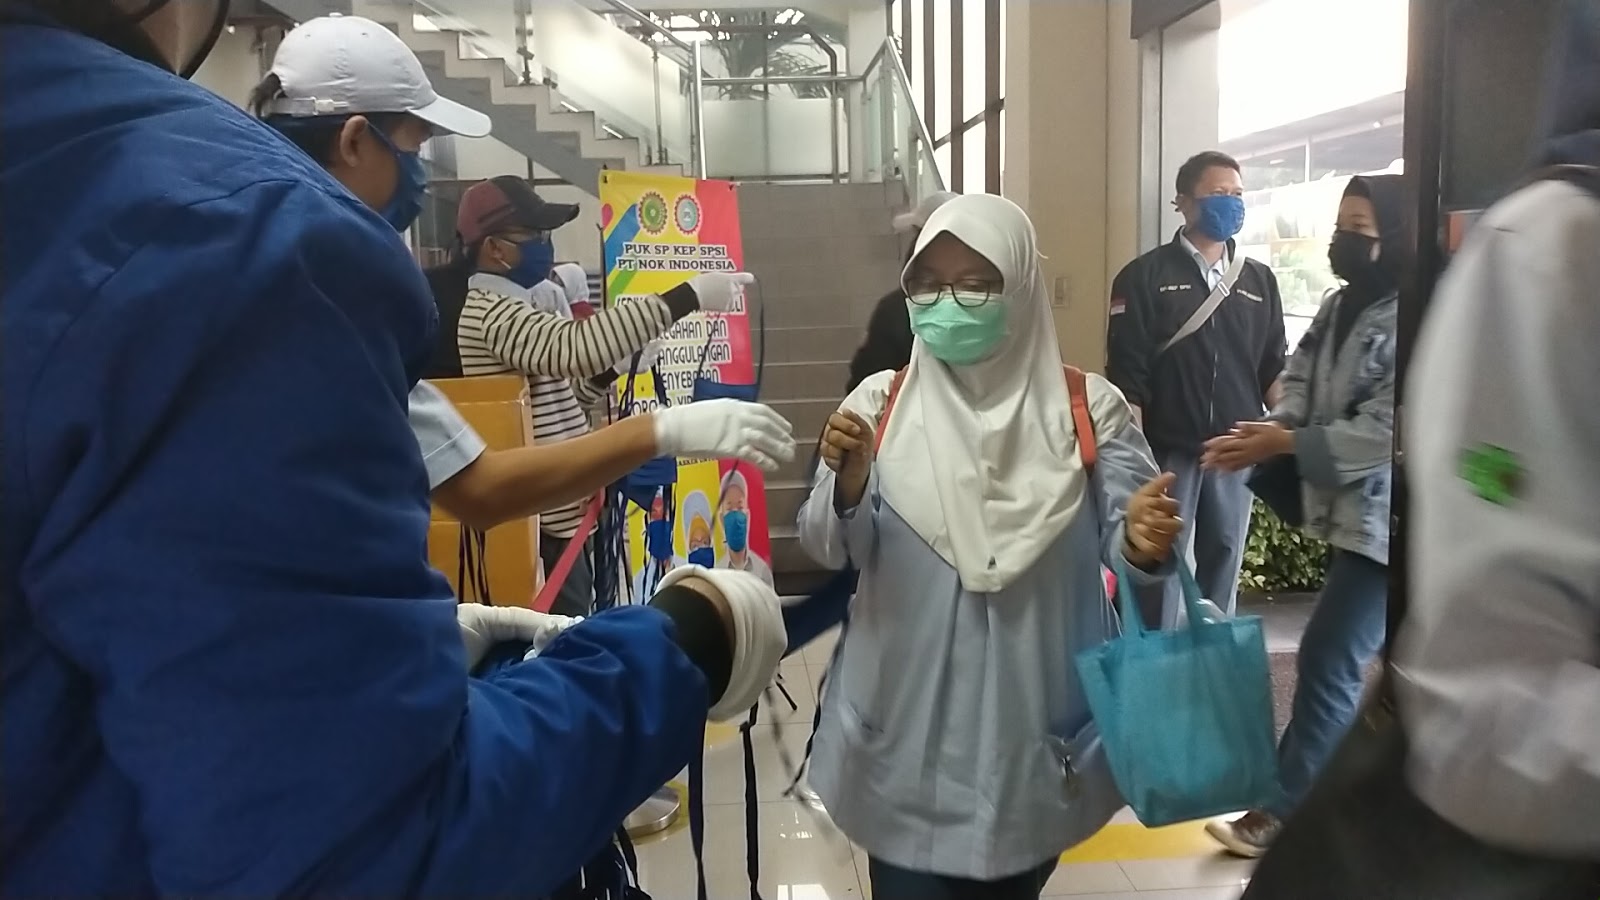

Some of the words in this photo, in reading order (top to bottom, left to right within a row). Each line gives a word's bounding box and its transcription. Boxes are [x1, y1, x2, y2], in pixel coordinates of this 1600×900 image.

[625, 243, 650, 255] PUK
[654, 244, 670, 255] SP
[673, 245, 696, 256] KEP
[700, 246, 725, 256] SPSI
[618, 259, 634, 269] PT
[639, 259, 665, 270] NOK
[669, 260, 734, 270] INDONESIA
[706, 320, 727, 337] DAN
